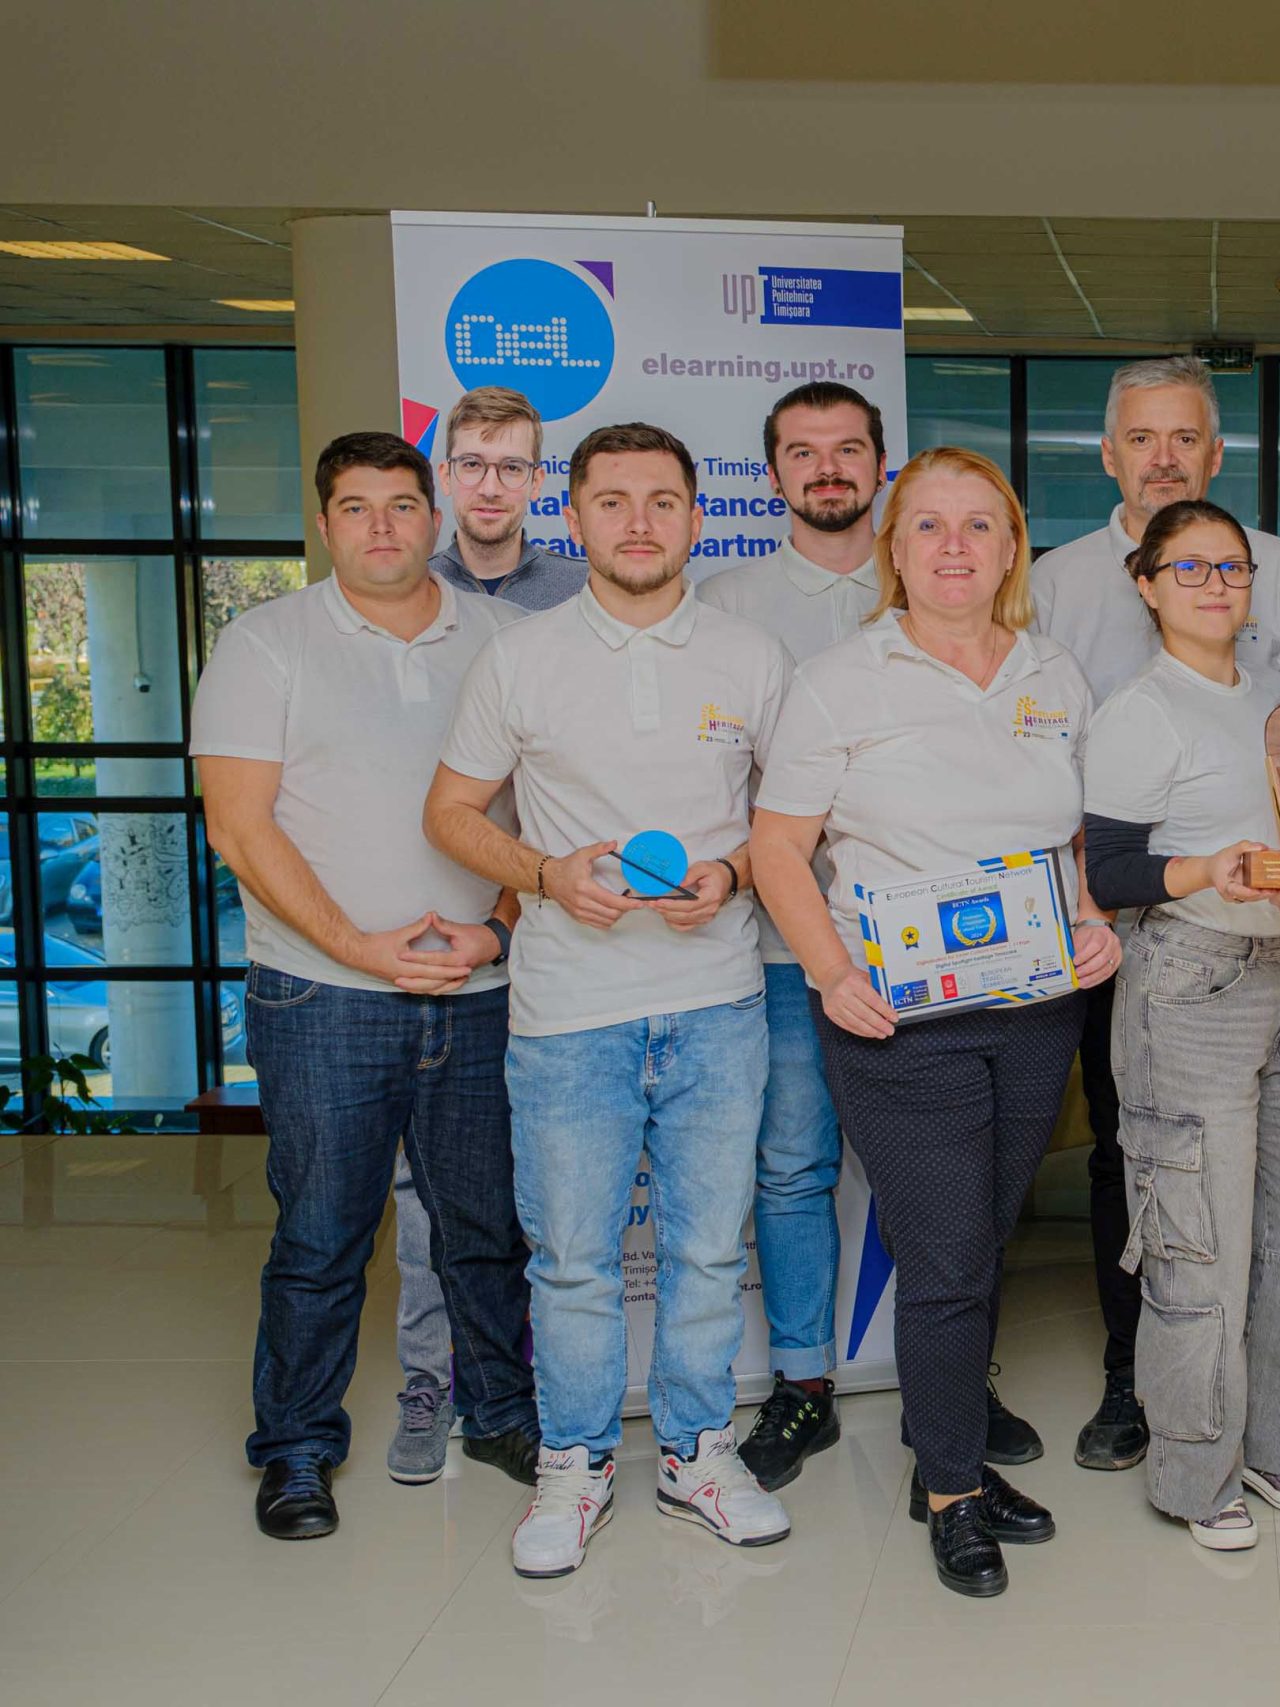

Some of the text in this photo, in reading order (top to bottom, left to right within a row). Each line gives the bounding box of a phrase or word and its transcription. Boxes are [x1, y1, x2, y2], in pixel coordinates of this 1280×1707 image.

[771, 275, 822, 290] Universitatea
[772, 289, 814, 304] Politehnica
[773, 303, 810, 319] Timișoara
[641, 352, 875, 383] elearning.upt.ro
[696, 493, 787, 517] tance
[930, 879, 965, 892] Cultural
[998, 867, 1033, 879] Network
[623, 1249, 655, 1263] Bd. Va
[624, 1264, 660, 1277] Timișo
[624, 1279, 641, 1289] Tel:
[624, 1292, 656, 1303] conta
